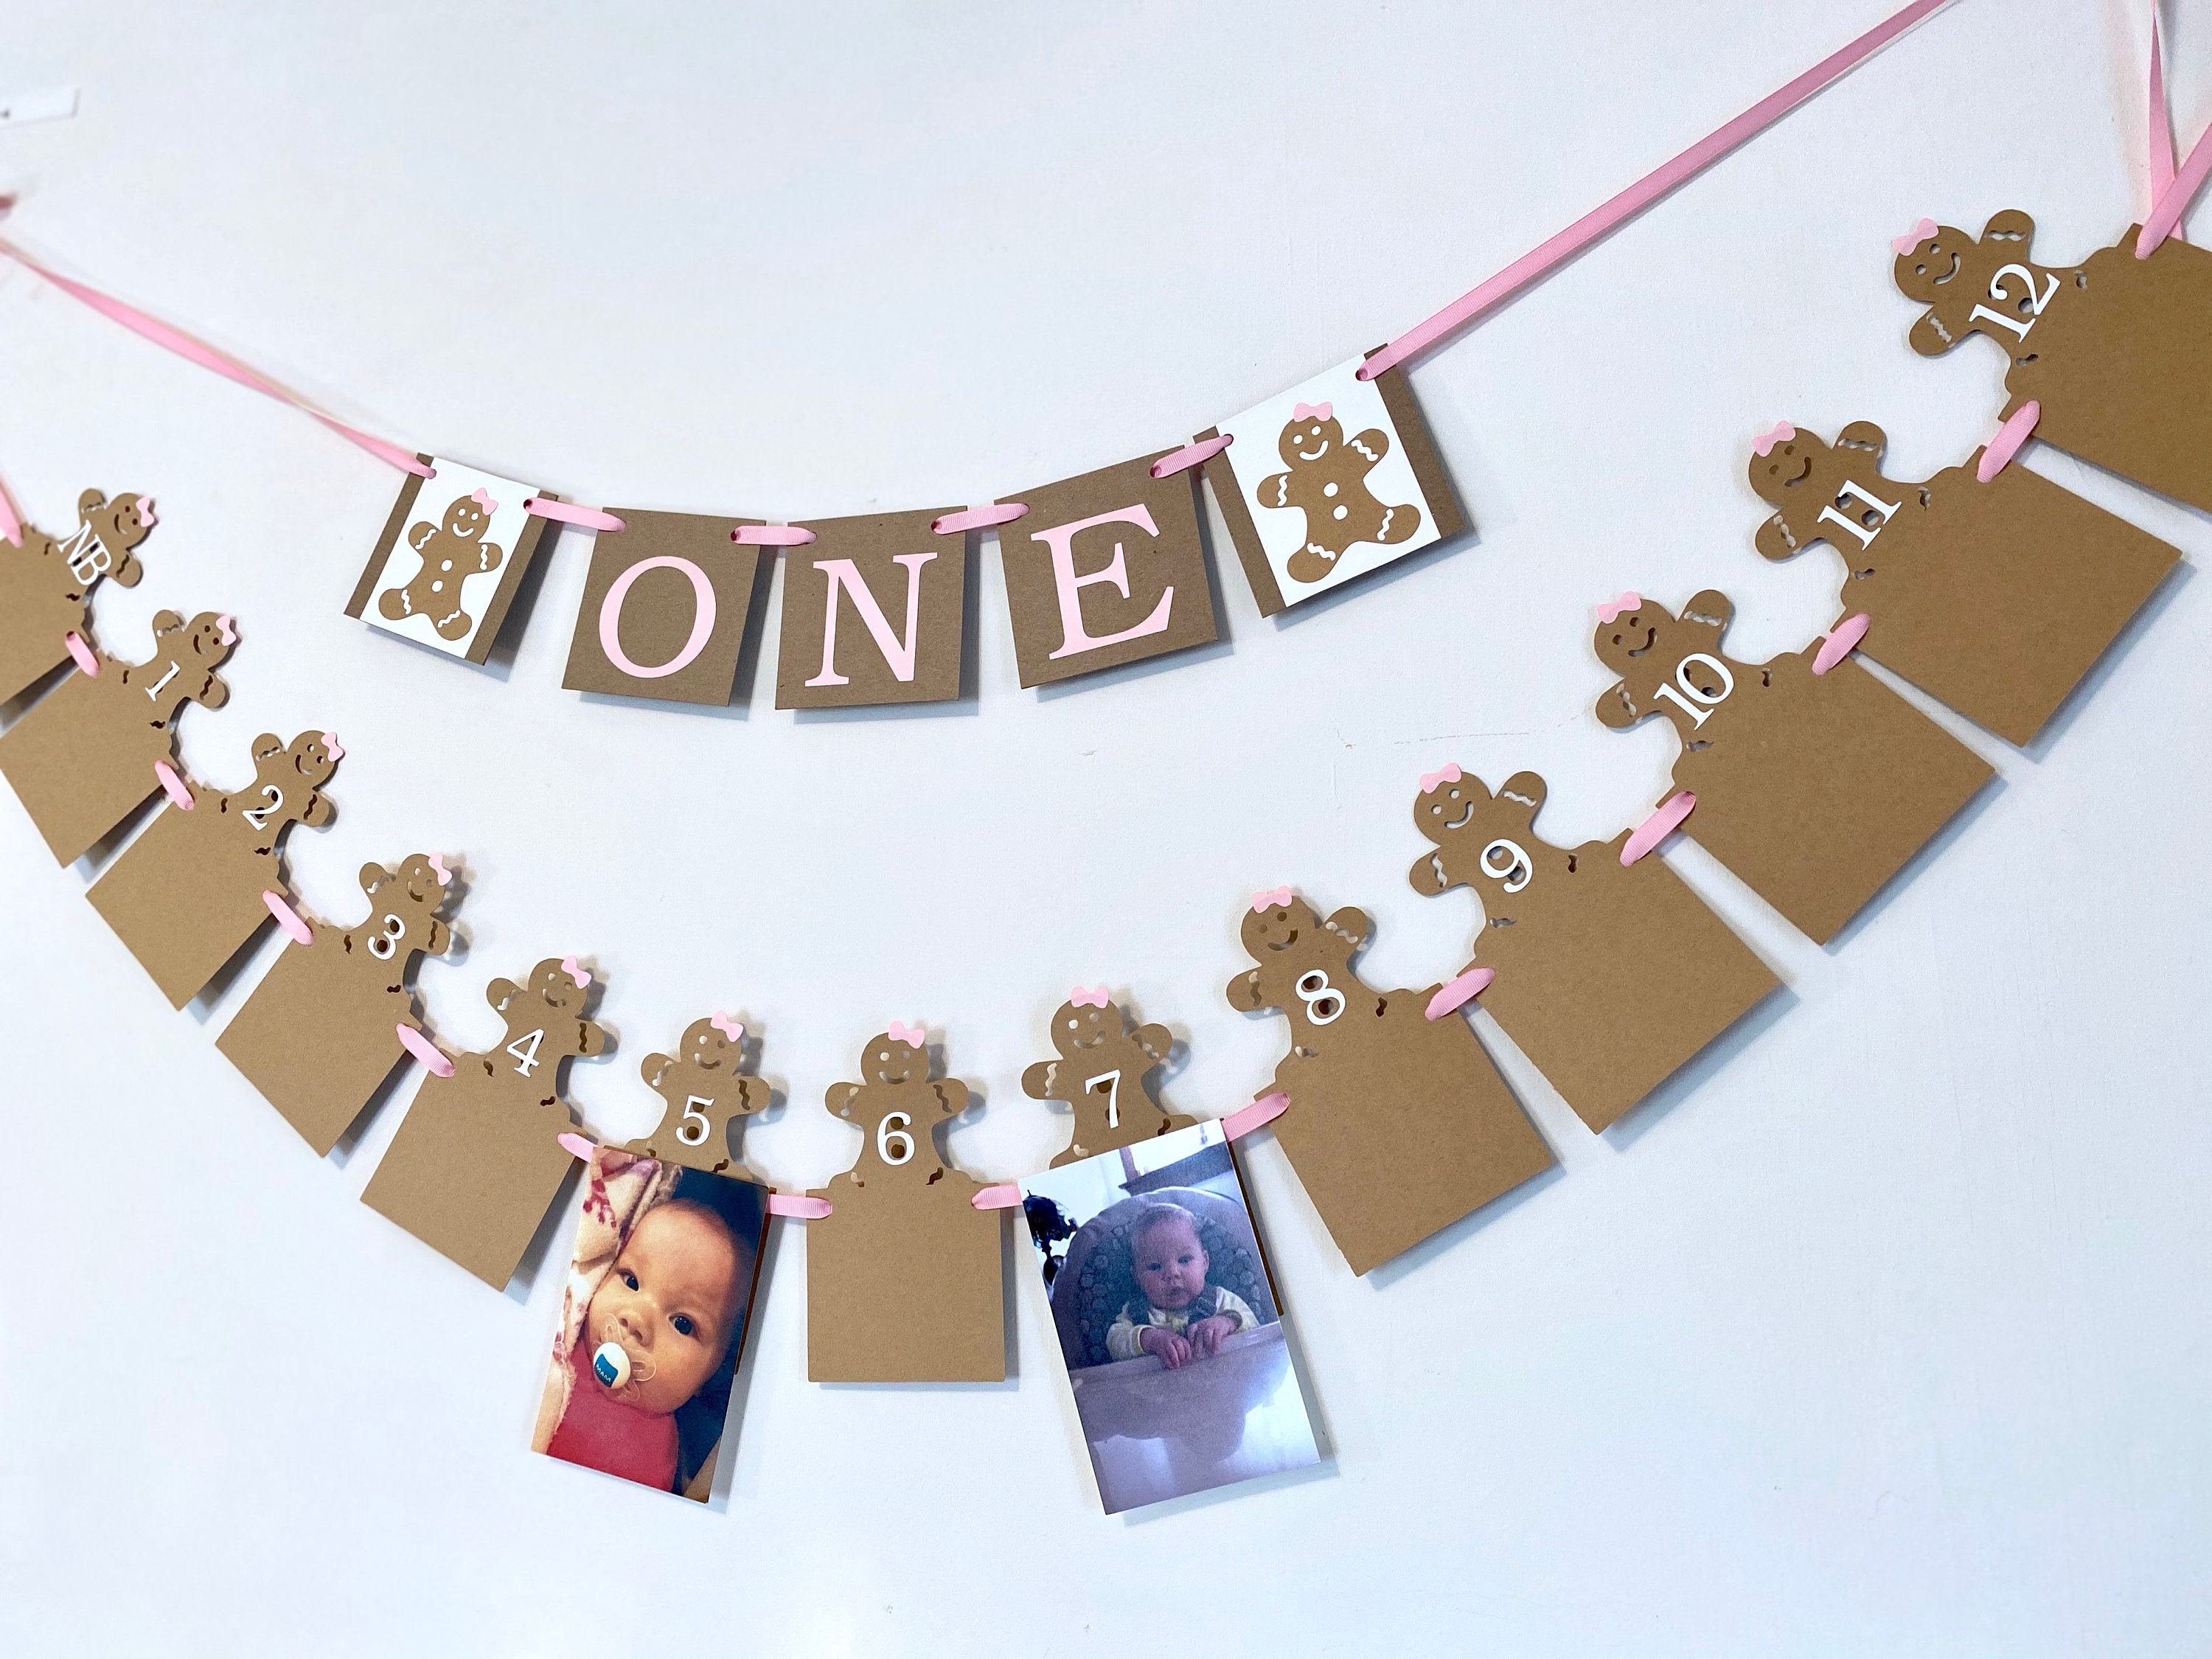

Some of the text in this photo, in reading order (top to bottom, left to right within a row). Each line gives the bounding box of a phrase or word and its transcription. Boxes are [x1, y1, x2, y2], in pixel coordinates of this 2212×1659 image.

[1969, 263, 2060, 344] 12
[1817, 479, 1902, 551] 11
[58, 520, 111, 586] NB
[598, 502, 1175, 687] ONE
[145, 661, 181, 702] 1
[1653, 653, 1734, 731] 10
[242, 785, 284, 831] 2
[1480, 838, 1534, 894] 9
[367, 914, 406, 961] 3
[1295, 968, 1346, 1026] 8
[506, 1028, 545, 1078] 4
[675, 1094, 714, 1147] 5
[1085, 1069, 1123, 1130] 7
[877, 1111, 916, 1166] 6
